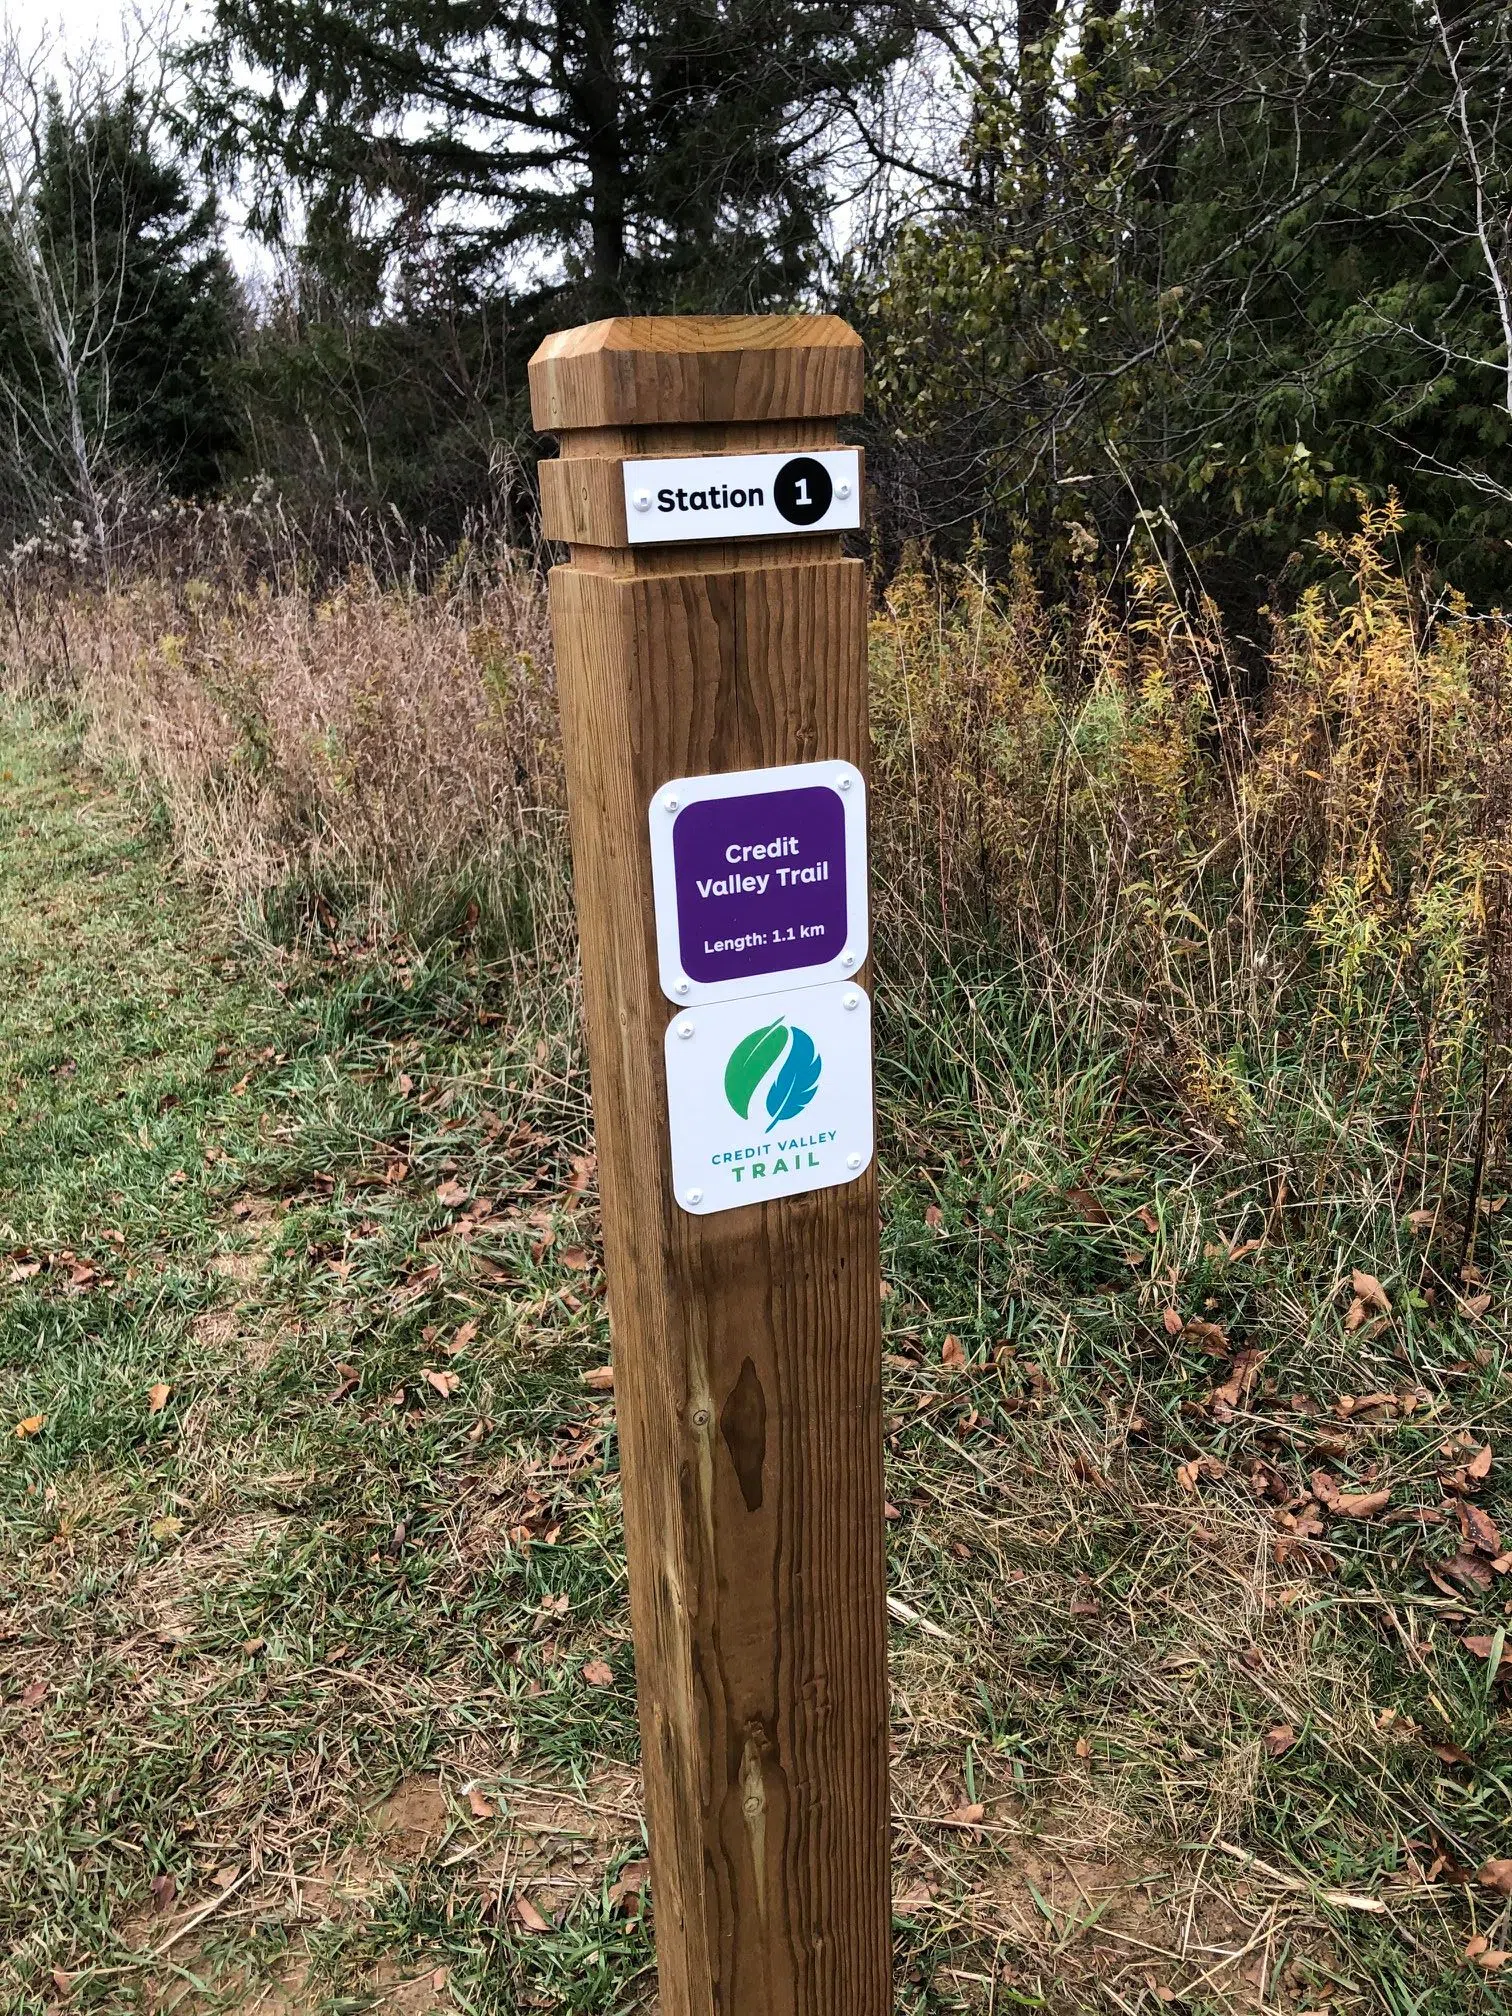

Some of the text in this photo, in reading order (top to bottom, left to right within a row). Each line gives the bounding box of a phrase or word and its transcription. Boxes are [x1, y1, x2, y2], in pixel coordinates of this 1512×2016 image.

[657, 478, 813, 512] Station 1
[725, 836, 800, 864] Credit
[696, 861, 829, 898] Valley Trail
[704, 924, 825, 954] Length: 1.1 km
[711, 1130, 837, 1165] CREDIT VALLEY
[731, 1152, 820, 1183] TRAIL
